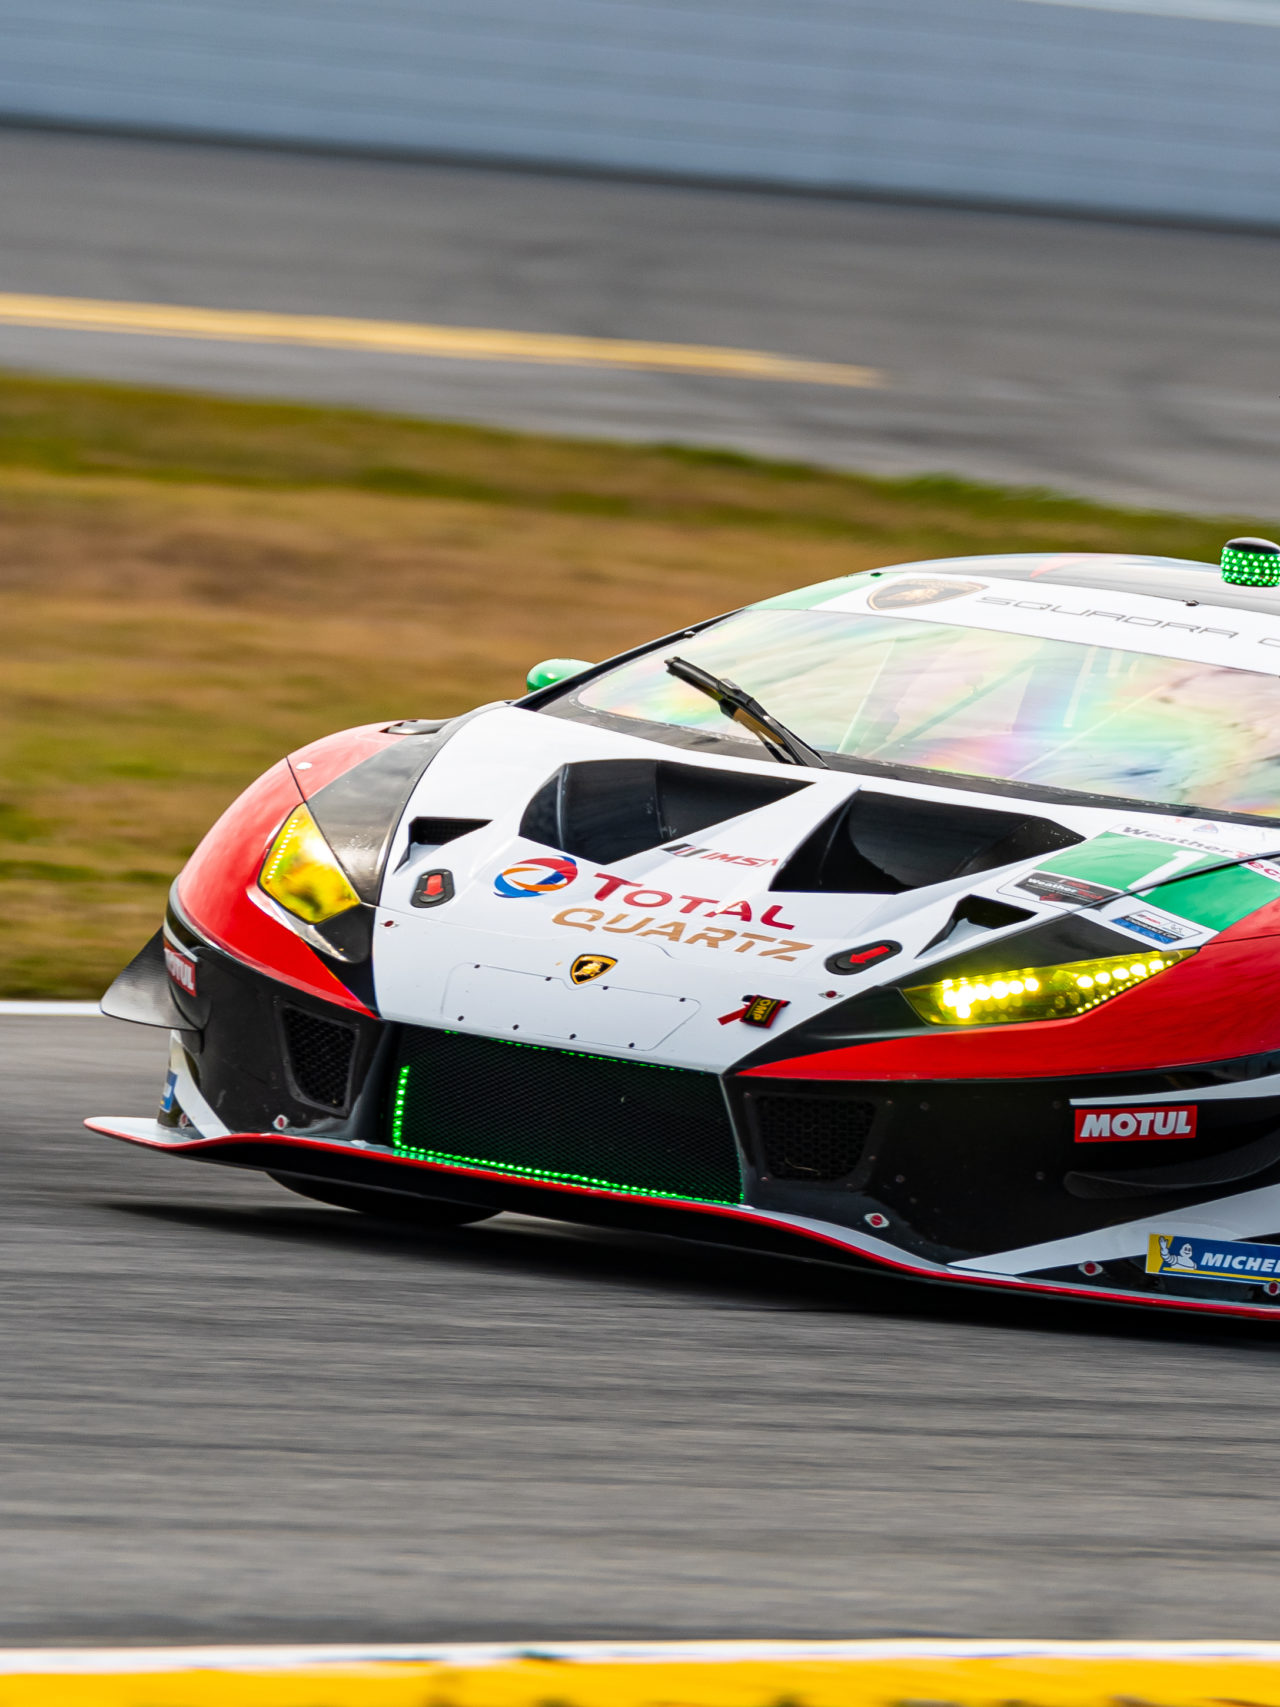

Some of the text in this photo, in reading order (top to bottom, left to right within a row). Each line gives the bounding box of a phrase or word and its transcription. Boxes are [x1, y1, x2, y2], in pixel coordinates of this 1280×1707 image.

[976, 595, 1239, 639] SQUADRA
[1126, 850, 1208, 897] 1
[593, 872, 796, 930] TOTAL
[551, 907, 815, 962] QUARTZ
[753, 999, 772, 1020] OMP
[1080, 1111, 1191, 1137] MOTUL
